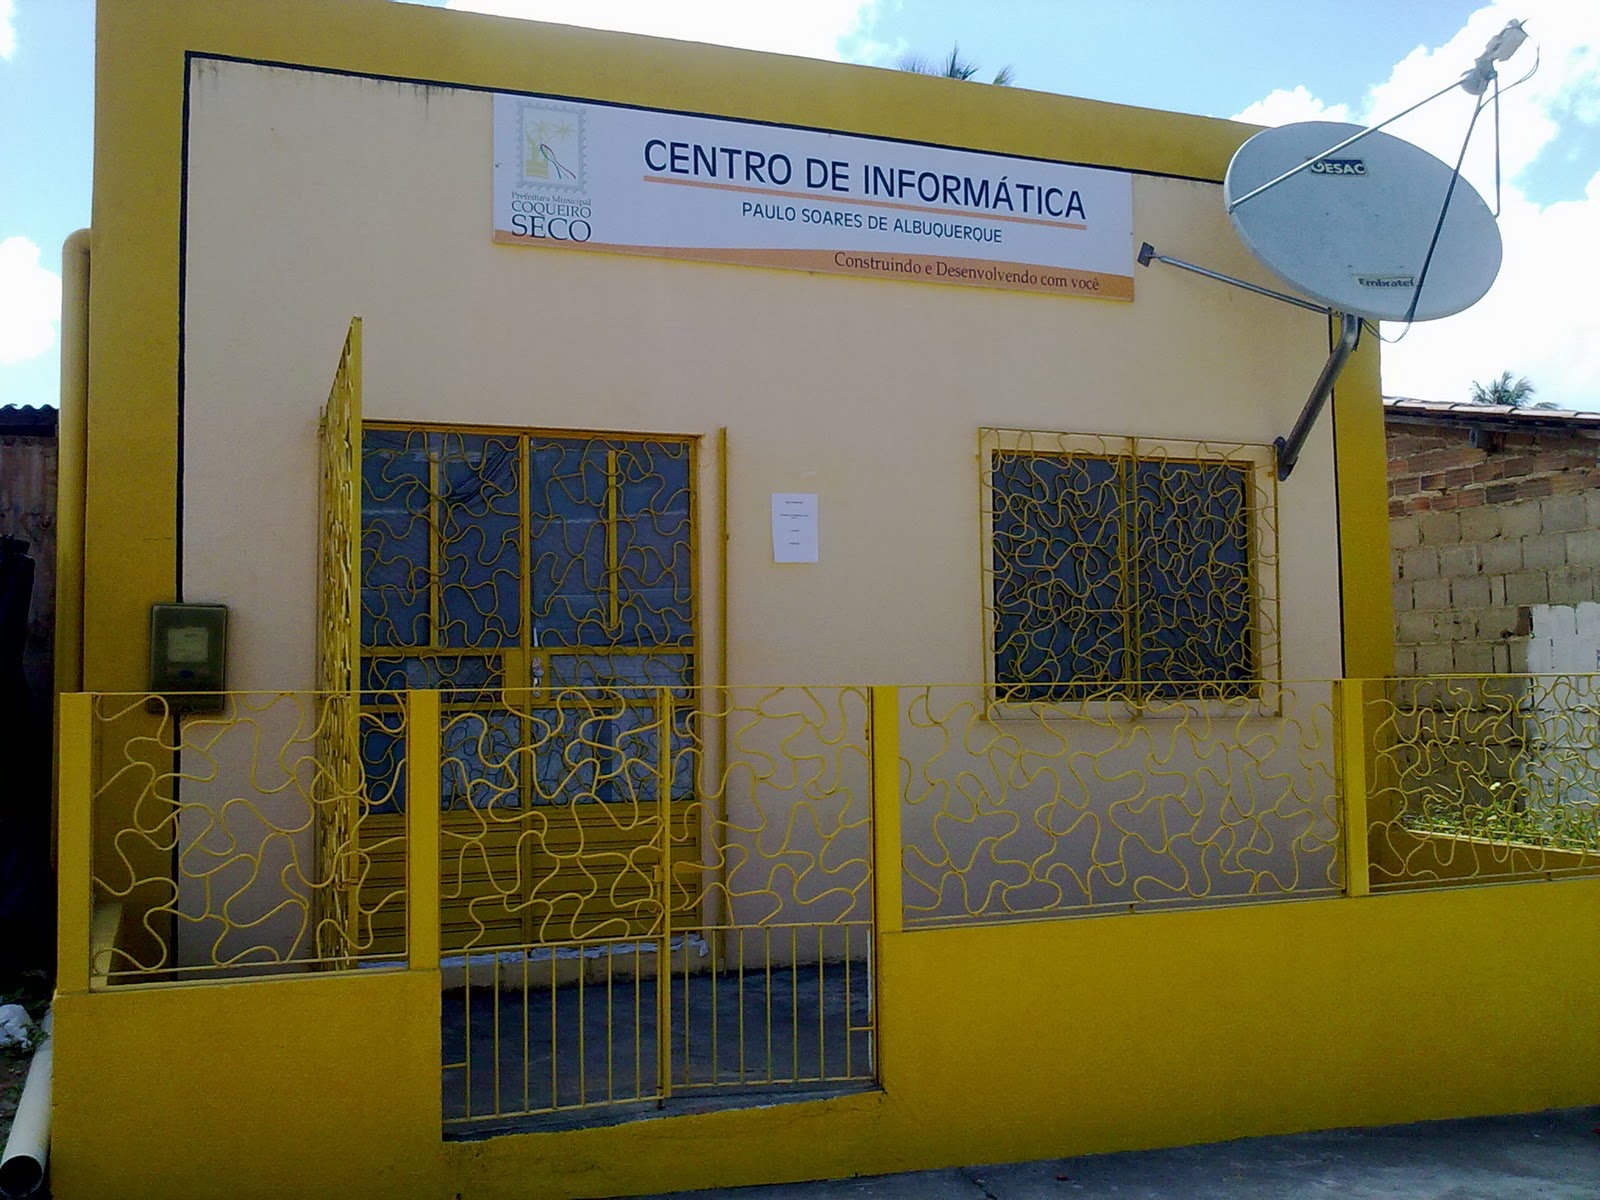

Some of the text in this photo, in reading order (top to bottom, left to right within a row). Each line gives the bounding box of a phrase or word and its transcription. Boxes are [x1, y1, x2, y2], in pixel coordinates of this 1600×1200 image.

[644, 139, 1086, 219] CENTRO DE INFORMÁTICA
[511, 200, 592, 218] COQUEIRO
[742, 202, 1002, 243] PAULO SOARES DE ALBUQUERQUE
[511, 214, 592, 242] SECO
[834, 252, 1099, 291] Construindo e Desenvolvendo com você
[1358, 277, 1415, 287] Embratel
